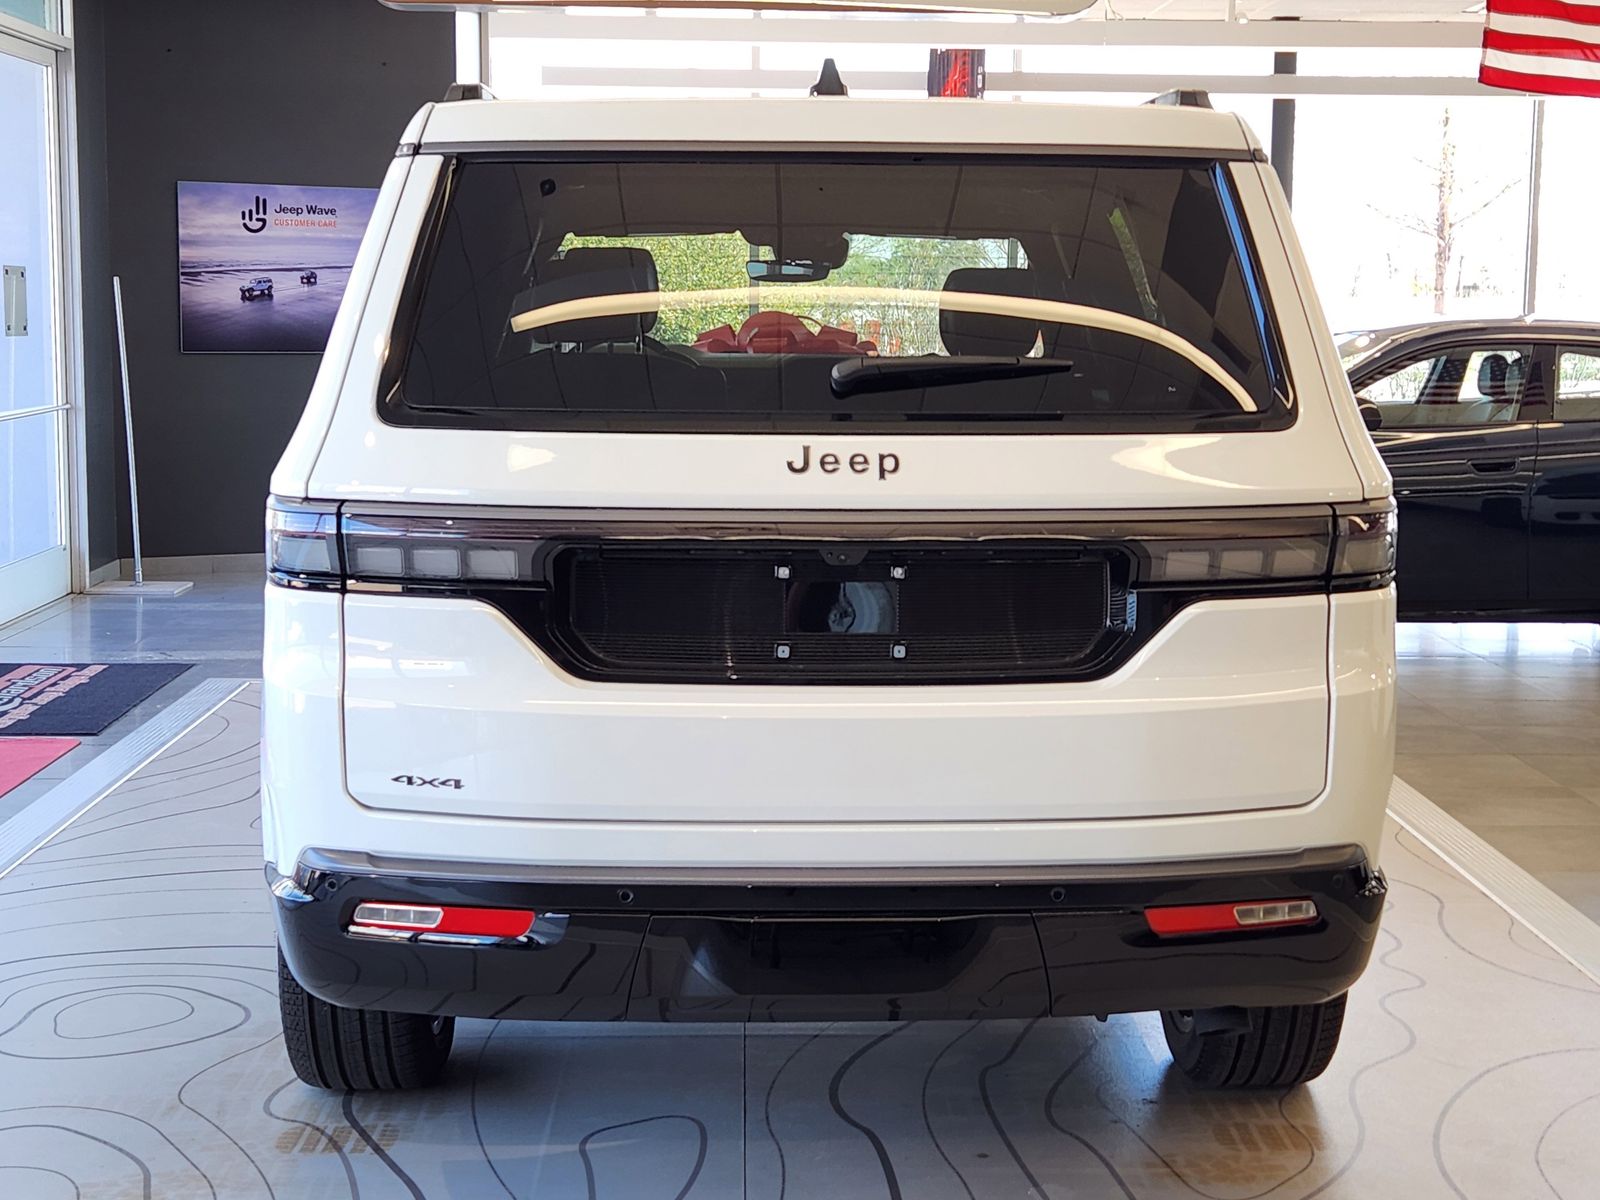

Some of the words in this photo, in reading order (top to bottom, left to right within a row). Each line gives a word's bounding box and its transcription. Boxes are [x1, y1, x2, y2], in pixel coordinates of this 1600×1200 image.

[274, 203, 304, 216] Jeep
[305, 204, 337, 216] Wave
[274, 218, 316, 227] CUSTOMER
[317, 219, 337, 228] CARE
[786, 445, 900, 480] Jeep
